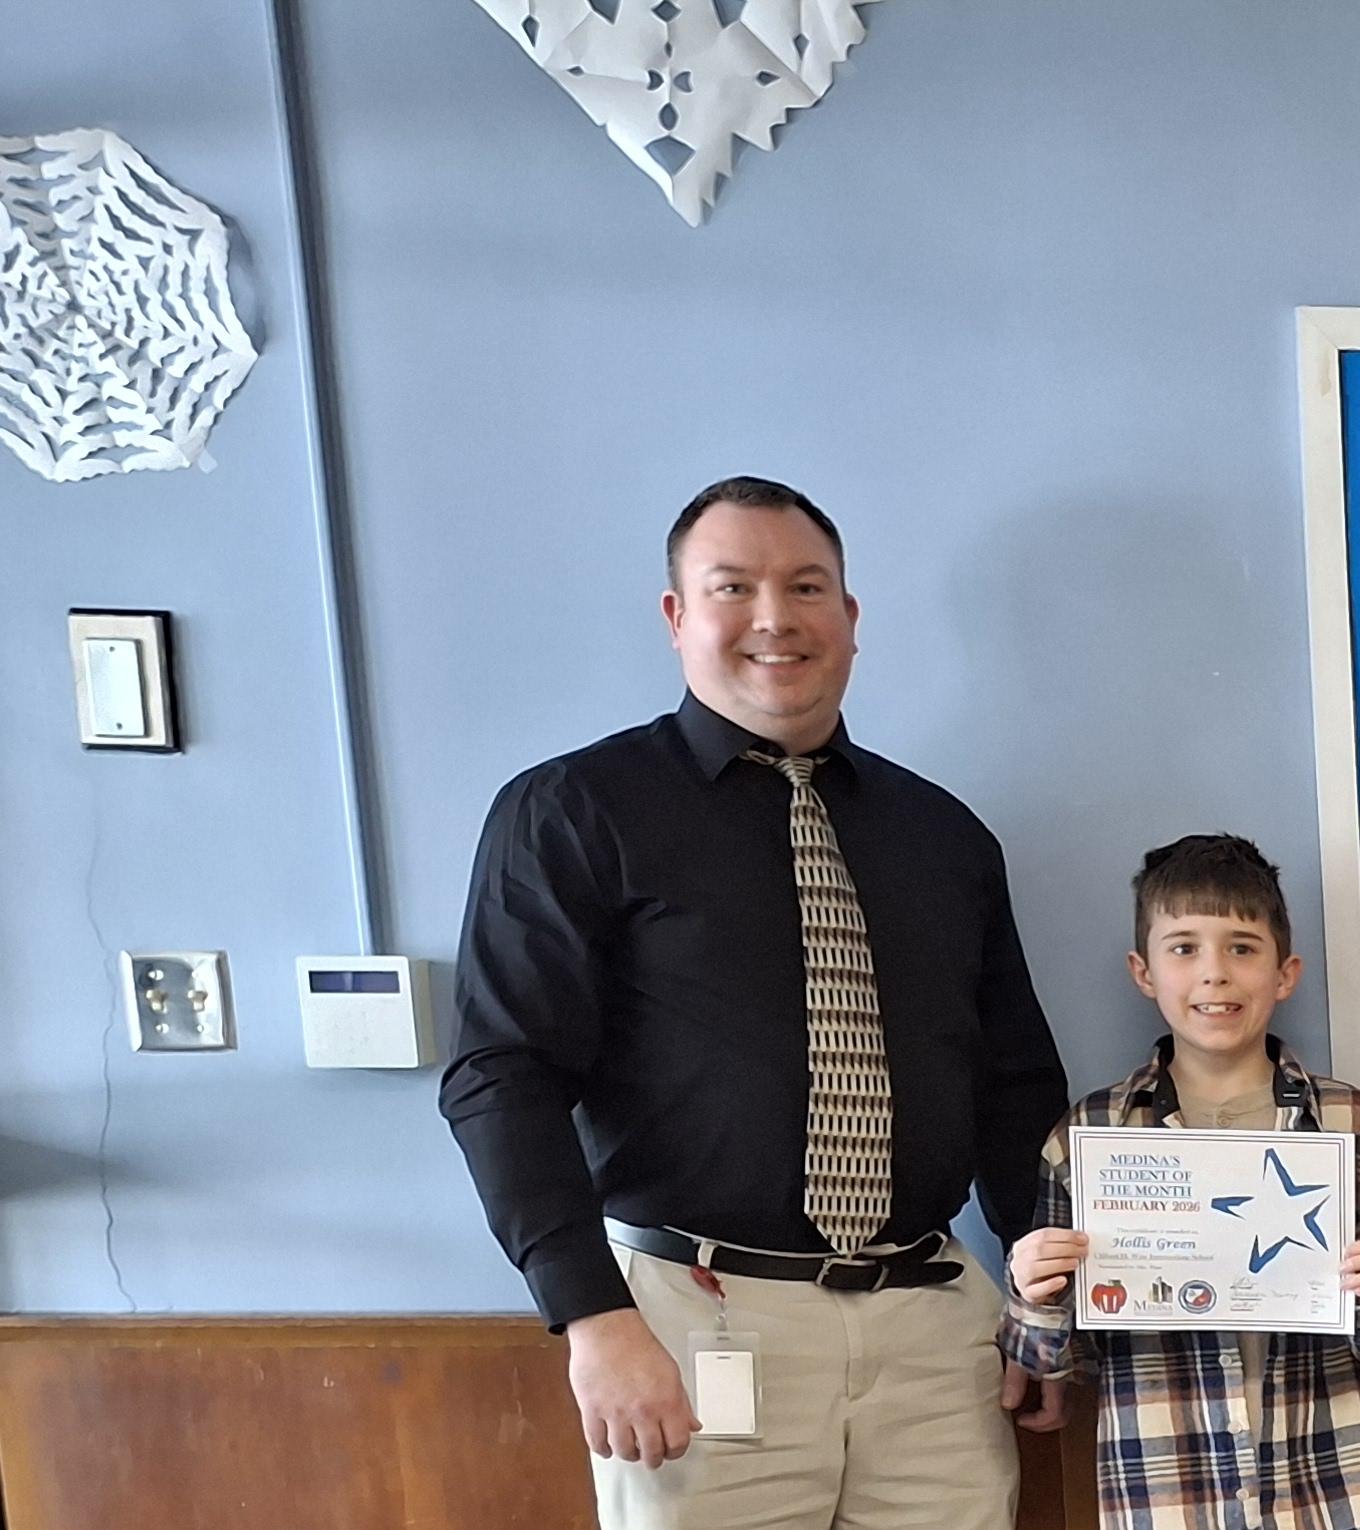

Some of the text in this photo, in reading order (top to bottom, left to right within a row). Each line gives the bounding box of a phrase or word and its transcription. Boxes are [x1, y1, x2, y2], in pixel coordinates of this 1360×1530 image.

[1110, 1154, 1181, 1165] MEDINA'S
[1099, 1169, 1192, 1181] STUDENT OF
[1100, 1184, 1192, 1196] THE MONTH
[1093, 1200, 1169, 1211] FEBRUARY
